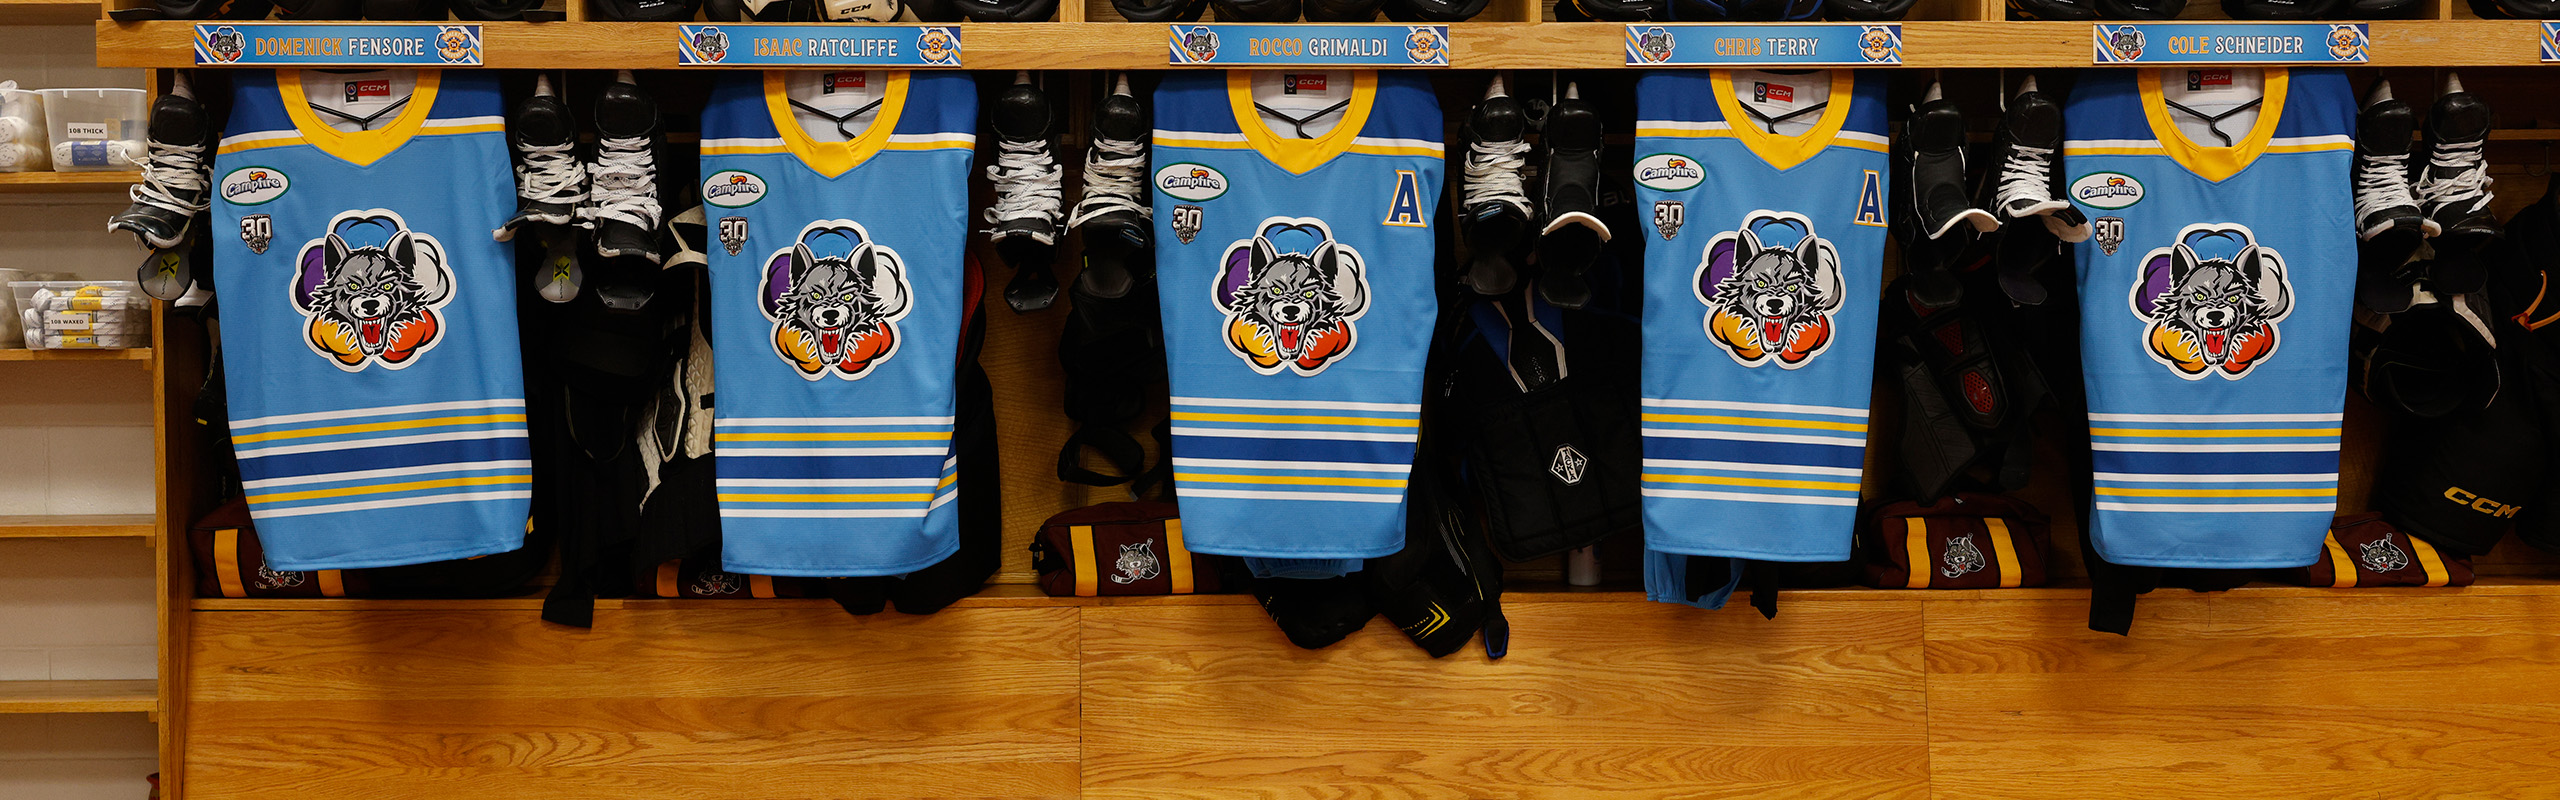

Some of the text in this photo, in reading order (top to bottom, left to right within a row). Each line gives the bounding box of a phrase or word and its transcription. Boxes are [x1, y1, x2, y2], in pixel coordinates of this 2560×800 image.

[841, 4, 872, 14] CCM
[255, 37, 425, 56] DOMENICK FENSORE
[754, 38, 899, 57] ISAAC RATCLIFFE
[1249, 38, 1388, 57] ROCCO GRIMALDI
[1714, 37, 1820, 56] CHRIS TERRY
[2168, 36, 2304, 54] COLE SCHNEIDER
[1768, 88, 1792, 97] CCM
[1163, 175, 1221, 190] Campfire
[1640, 165, 1698, 181] Campfire
[226, 177, 281, 198] Campfire
[707, 181, 759, 199] Campfire
[2079, 183, 2137, 199] Campfire
[1382, 169, 1428, 228] A
[1853, 169, 1888, 228] A
[1172, 207, 1203, 231] 30
[1654, 204, 1684, 227] 30
[241, 217, 272, 241] 30
[719, 220, 748, 242] 30
[2095, 220, 2124, 241] 30
[2443, 486, 2522, 519] CCM
